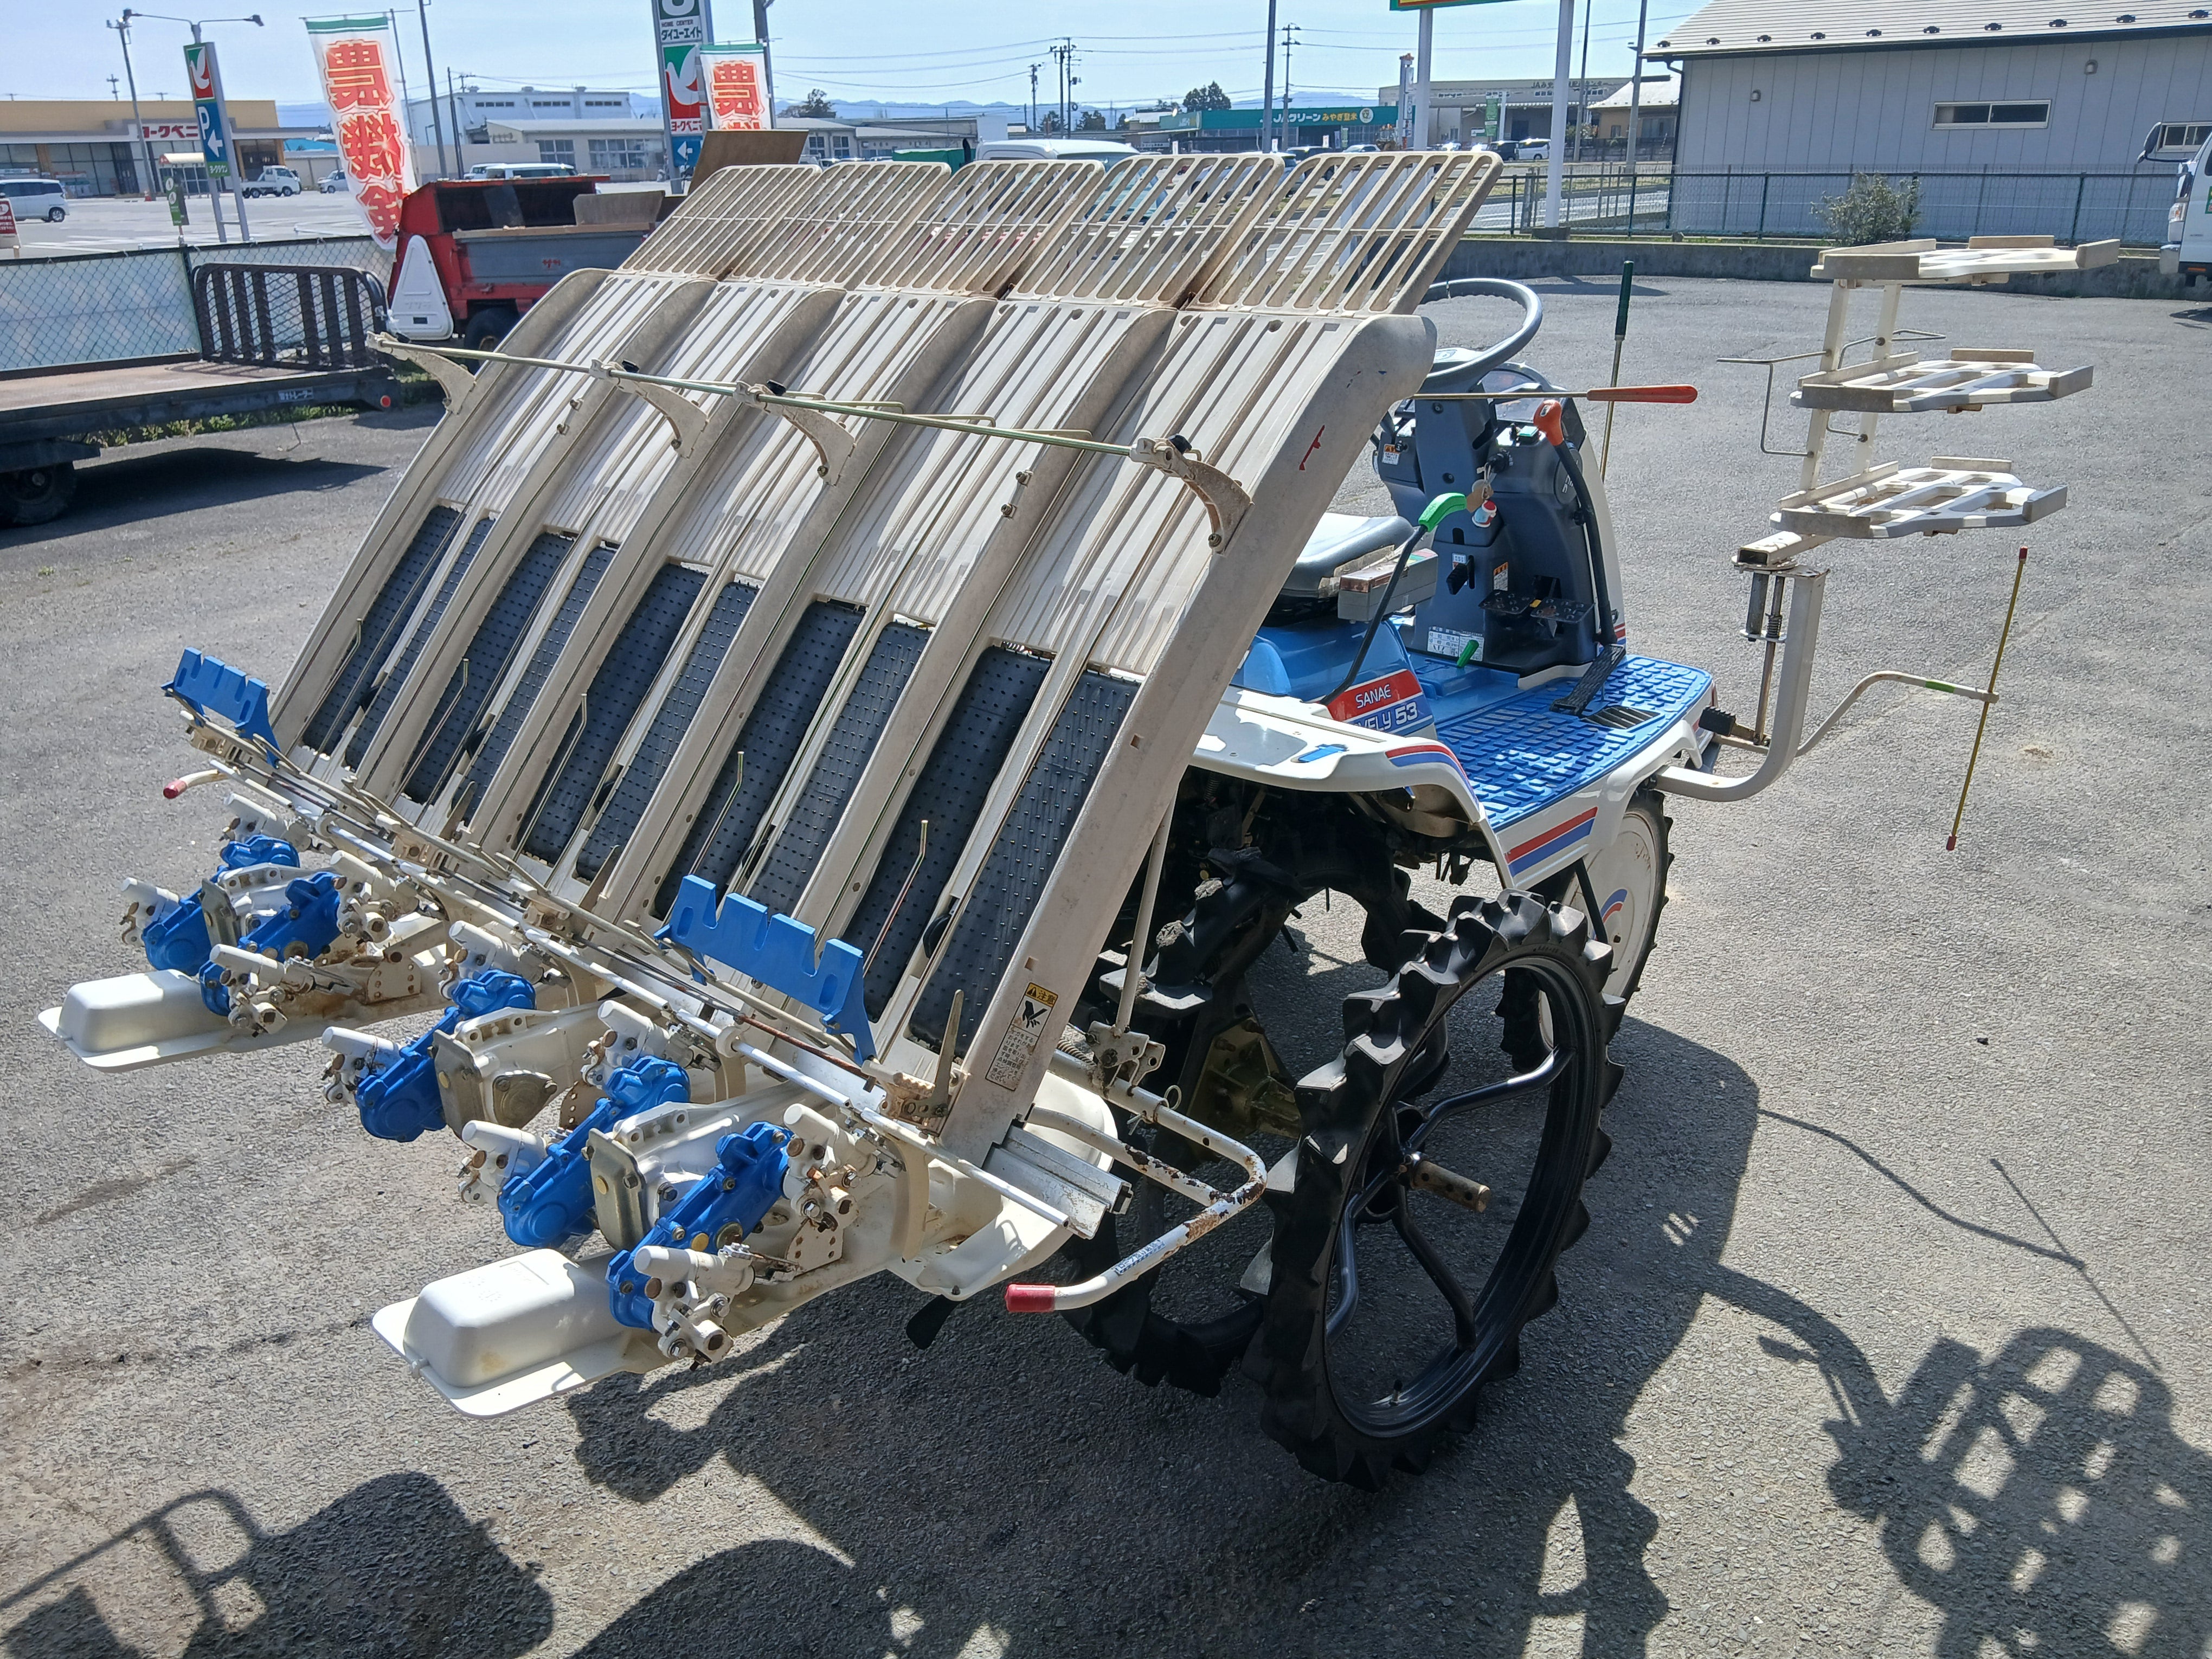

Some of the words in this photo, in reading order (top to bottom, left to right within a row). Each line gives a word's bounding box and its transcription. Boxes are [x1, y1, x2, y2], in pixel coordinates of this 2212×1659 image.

[661, 26, 703, 41] ダイユーエイト
[198, 106, 210, 140] P
[1355, 684, 1392, 709] SANAE
[1396, 702, 1418, 725] 53
[1036, 989, 1056, 1005] 注意
